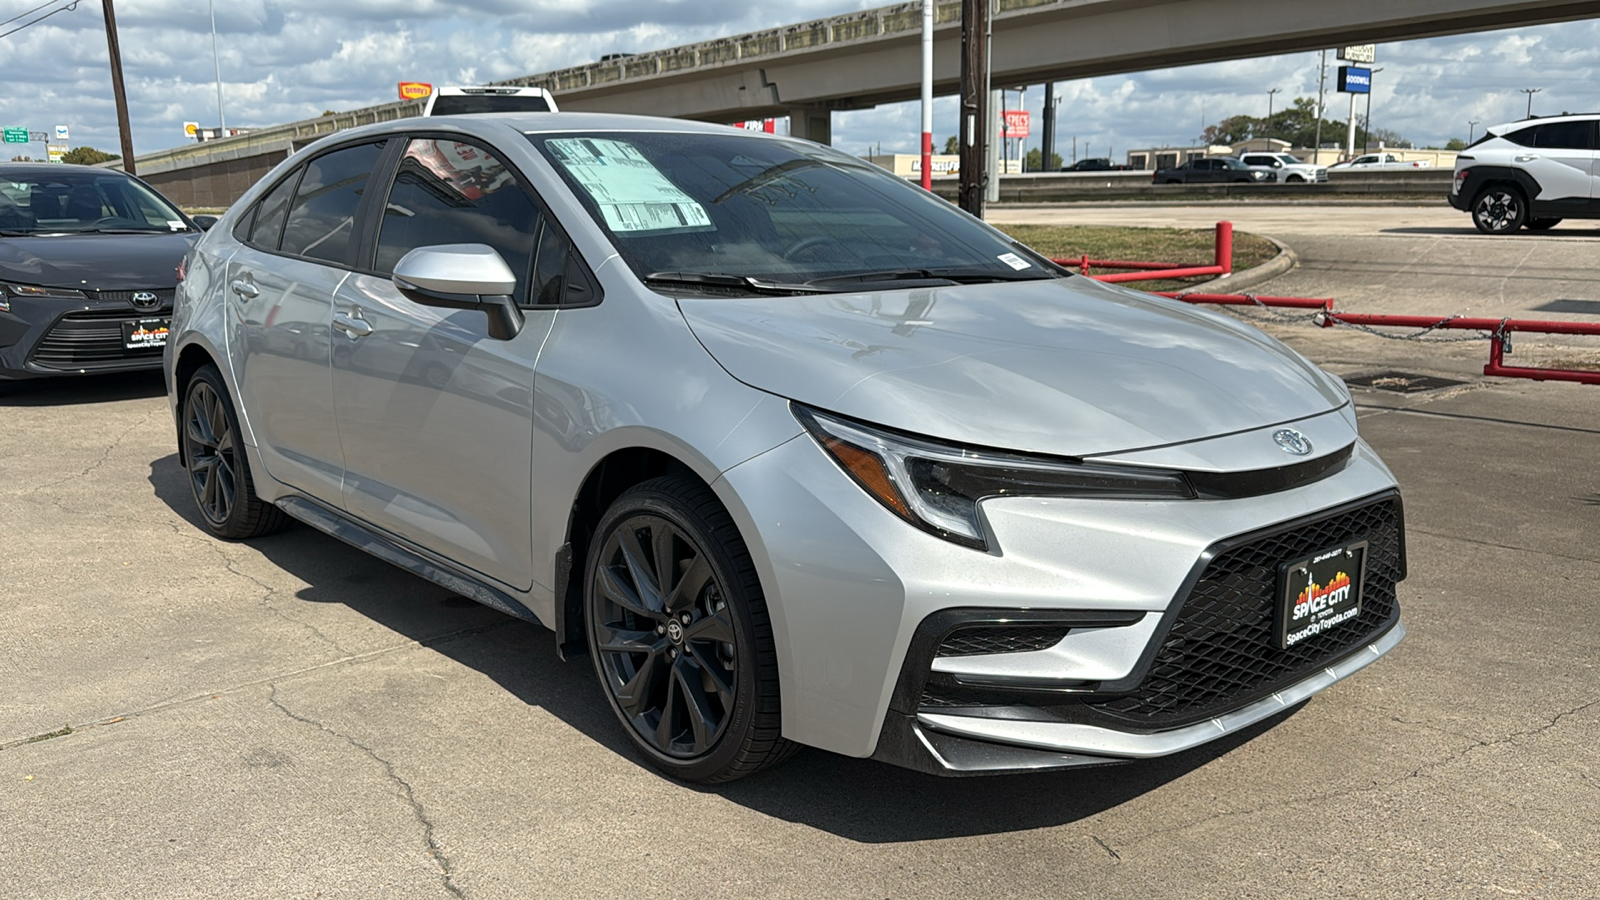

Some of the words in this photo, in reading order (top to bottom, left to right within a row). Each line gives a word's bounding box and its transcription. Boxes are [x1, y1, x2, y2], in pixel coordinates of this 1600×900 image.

[1346, 75, 1369, 85] GOODWILL
[405, 87, 428, 95] Denny's
[1293, 594, 1327, 620] SPACE
[1328, 584, 1350, 605] CITY
[1317, 607, 1334, 619] TOYOTA
[1286, 607, 1358, 645] SpaceCityToyota.com
